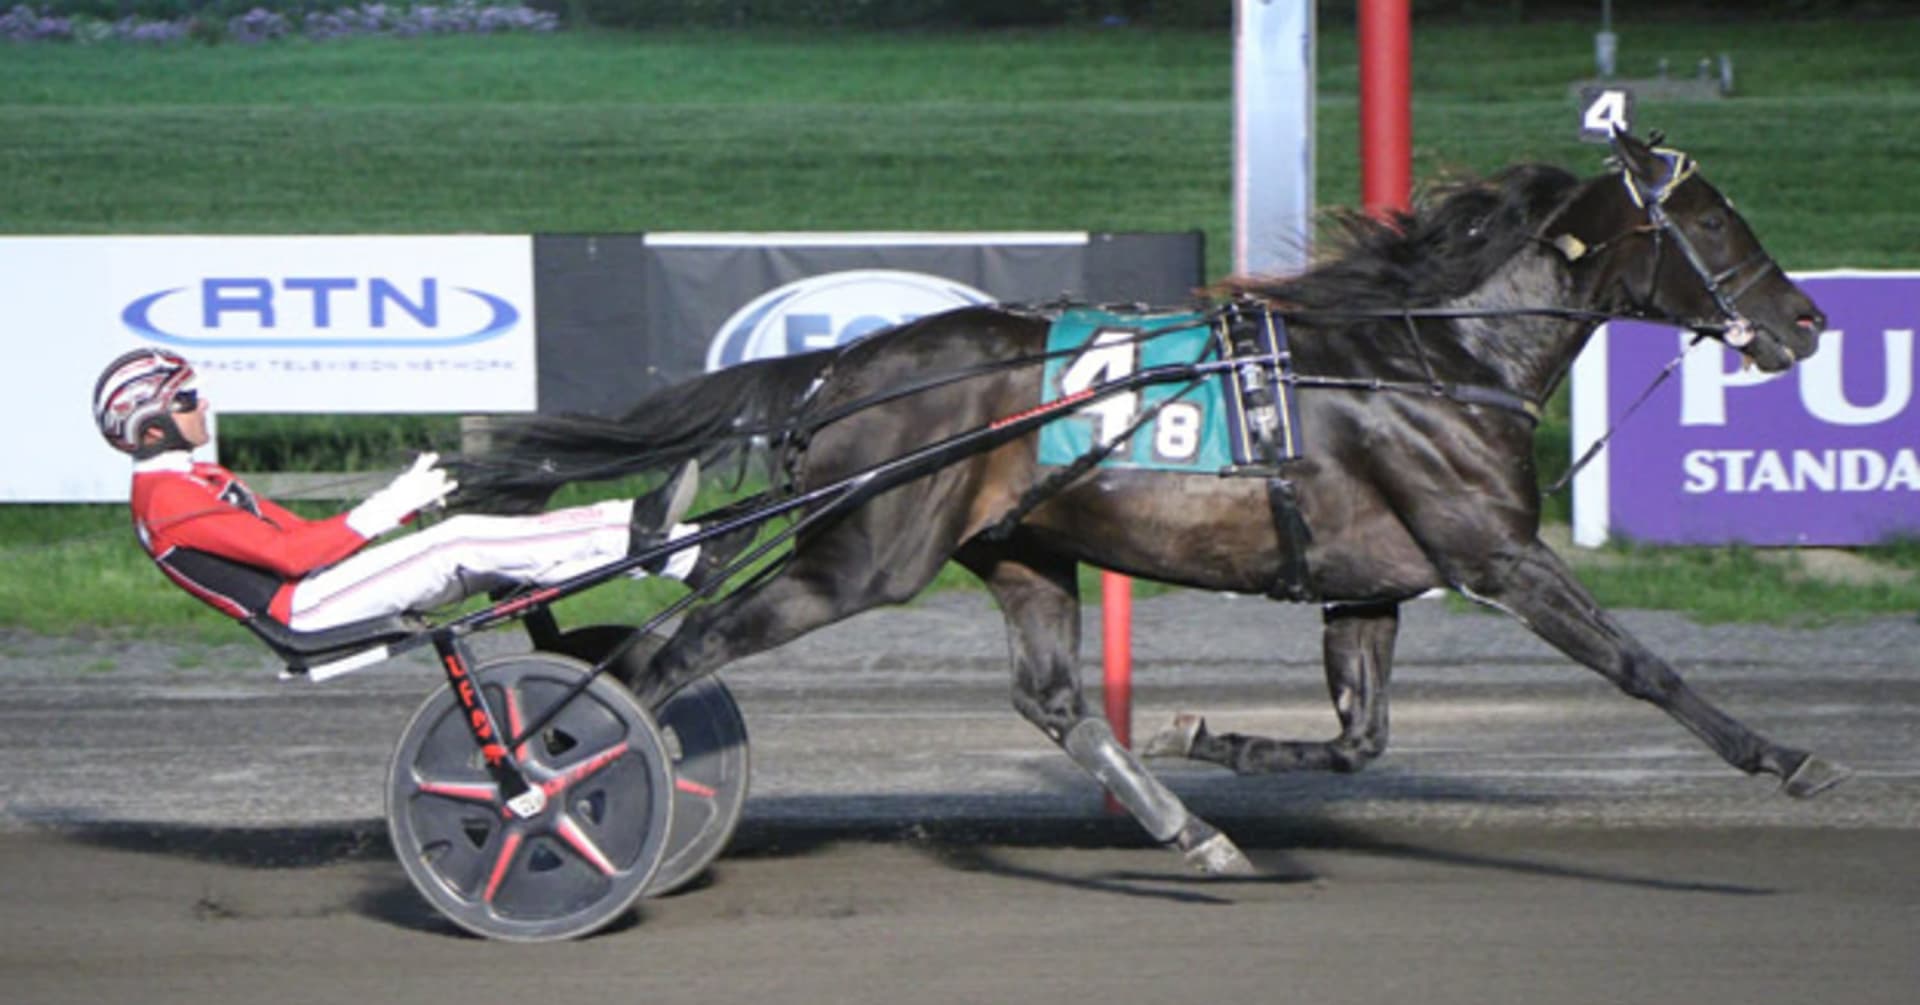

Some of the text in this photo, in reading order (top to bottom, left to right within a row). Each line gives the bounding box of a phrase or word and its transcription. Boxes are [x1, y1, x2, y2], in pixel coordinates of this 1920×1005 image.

[1584, 89, 1627, 139] 4
[201, 276, 438, 328] RTN
[407, 358, 516, 372] NETWORK
[1060, 329, 1137, 454] 4
[1156, 402, 1200, 458] 8
[1683, 449, 1920, 493] STANDA
